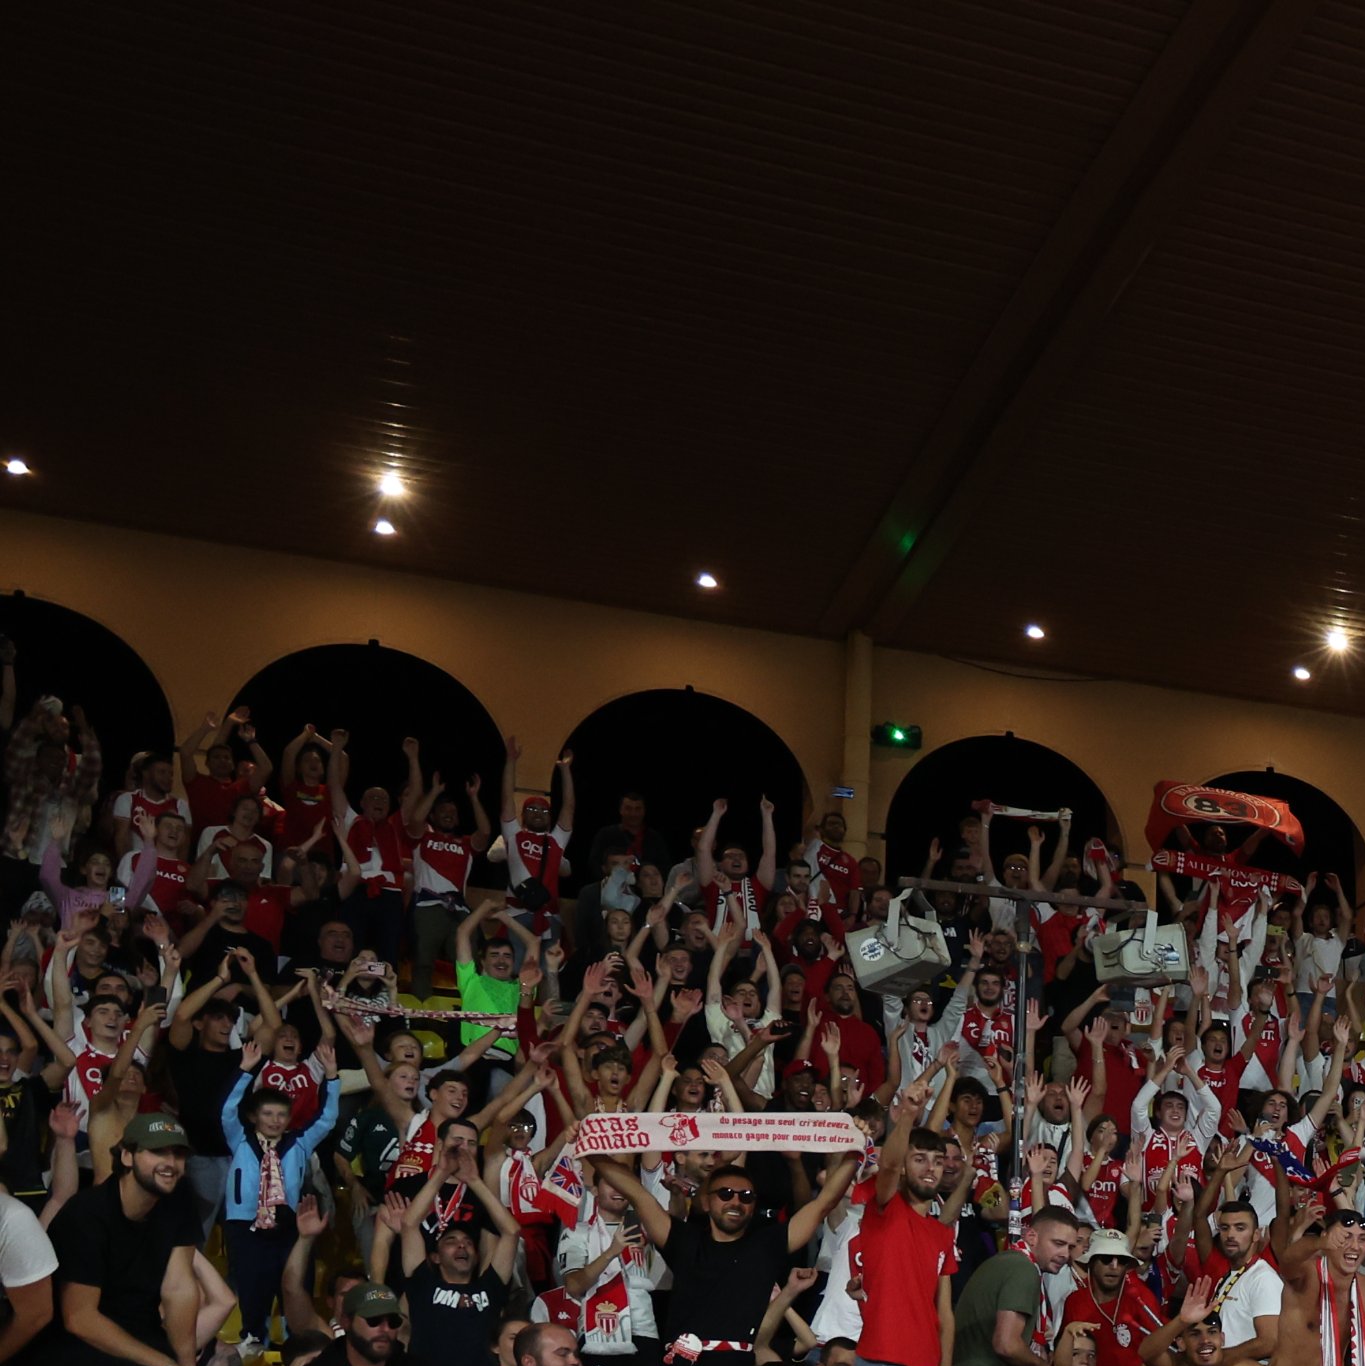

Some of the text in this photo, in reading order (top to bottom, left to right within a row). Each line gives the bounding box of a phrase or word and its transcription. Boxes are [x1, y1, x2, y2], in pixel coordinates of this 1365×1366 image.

[732, 1117, 763, 1128] pesage
[711, 1131, 743, 1140] monaco
[745, 1132, 770, 1142] gagne
[772, 1133, 790, 1143] pour
